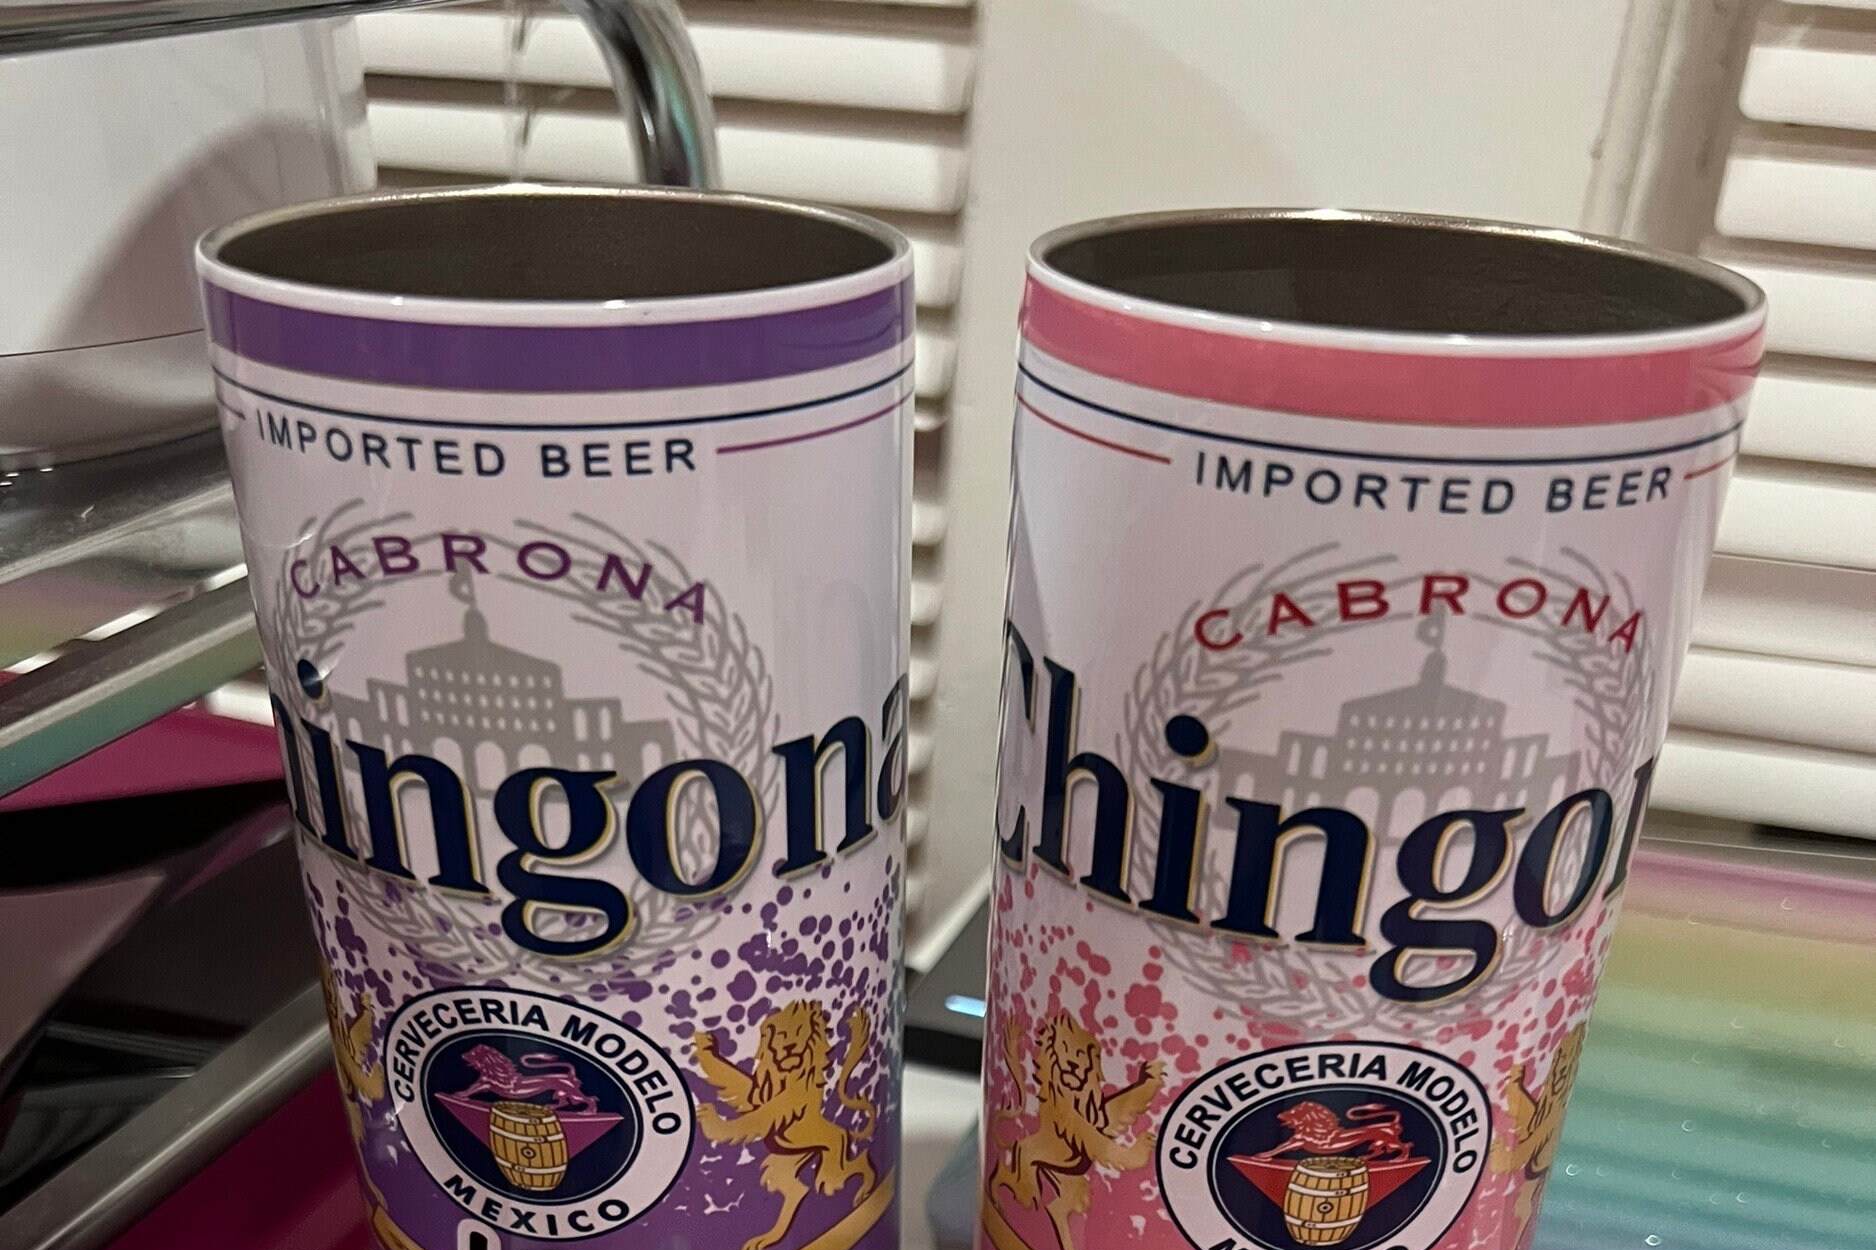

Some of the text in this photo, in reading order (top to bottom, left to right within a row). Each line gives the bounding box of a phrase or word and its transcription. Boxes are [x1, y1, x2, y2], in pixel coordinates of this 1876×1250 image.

[257, 410, 697, 479] IMPORTED BEER
[1195, 451, 1673, 514] IMPORTED BEER
[290, 533, 708, 625] CABRONA
[1193, 574, 1644, 655] CABRONA
[393, 997, 682, 1136] CERVECERIA MODELO
[1168, 1052, 1480, 1174] CERVECERIA MODELO
[444, 1174, 630, 1237] MEXICO
